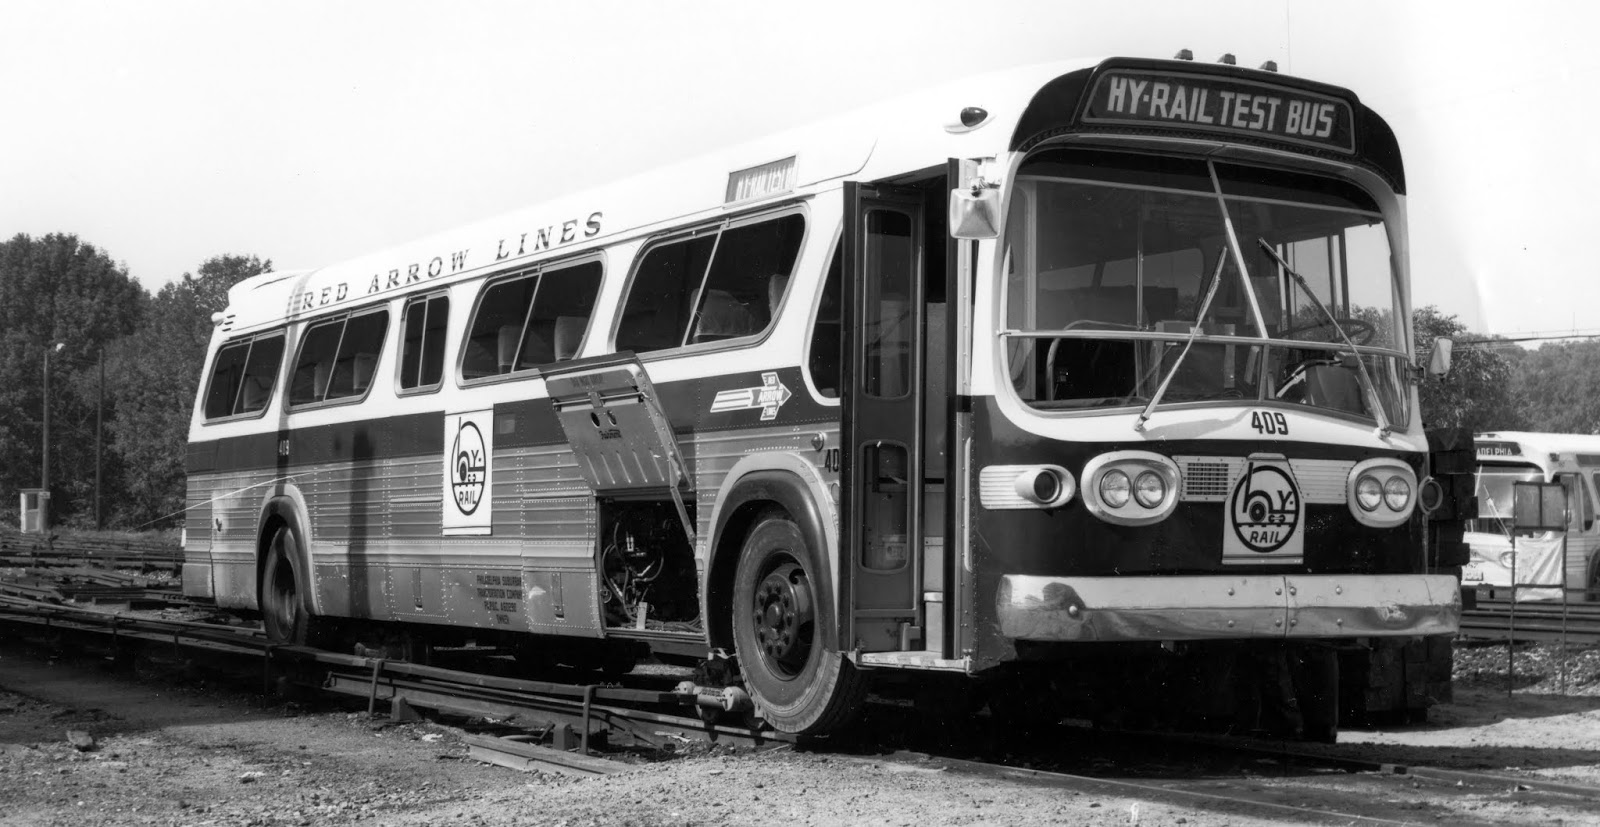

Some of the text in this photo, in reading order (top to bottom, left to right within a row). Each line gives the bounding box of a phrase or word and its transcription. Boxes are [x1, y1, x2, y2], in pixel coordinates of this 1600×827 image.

[1107, 76, 1336, 138] HY-RAIL TEST BUS
[301, 211, 604, 310] RED ARROW LINES
[1251, 411, 1289, 435] 409
[825, 448, 840, 473] 40
[1476, 447, 1513, 456] ADELPHIA
[458, 490, 477, 505] RAIL
[1250, 530, 1281, 544] RAIL
